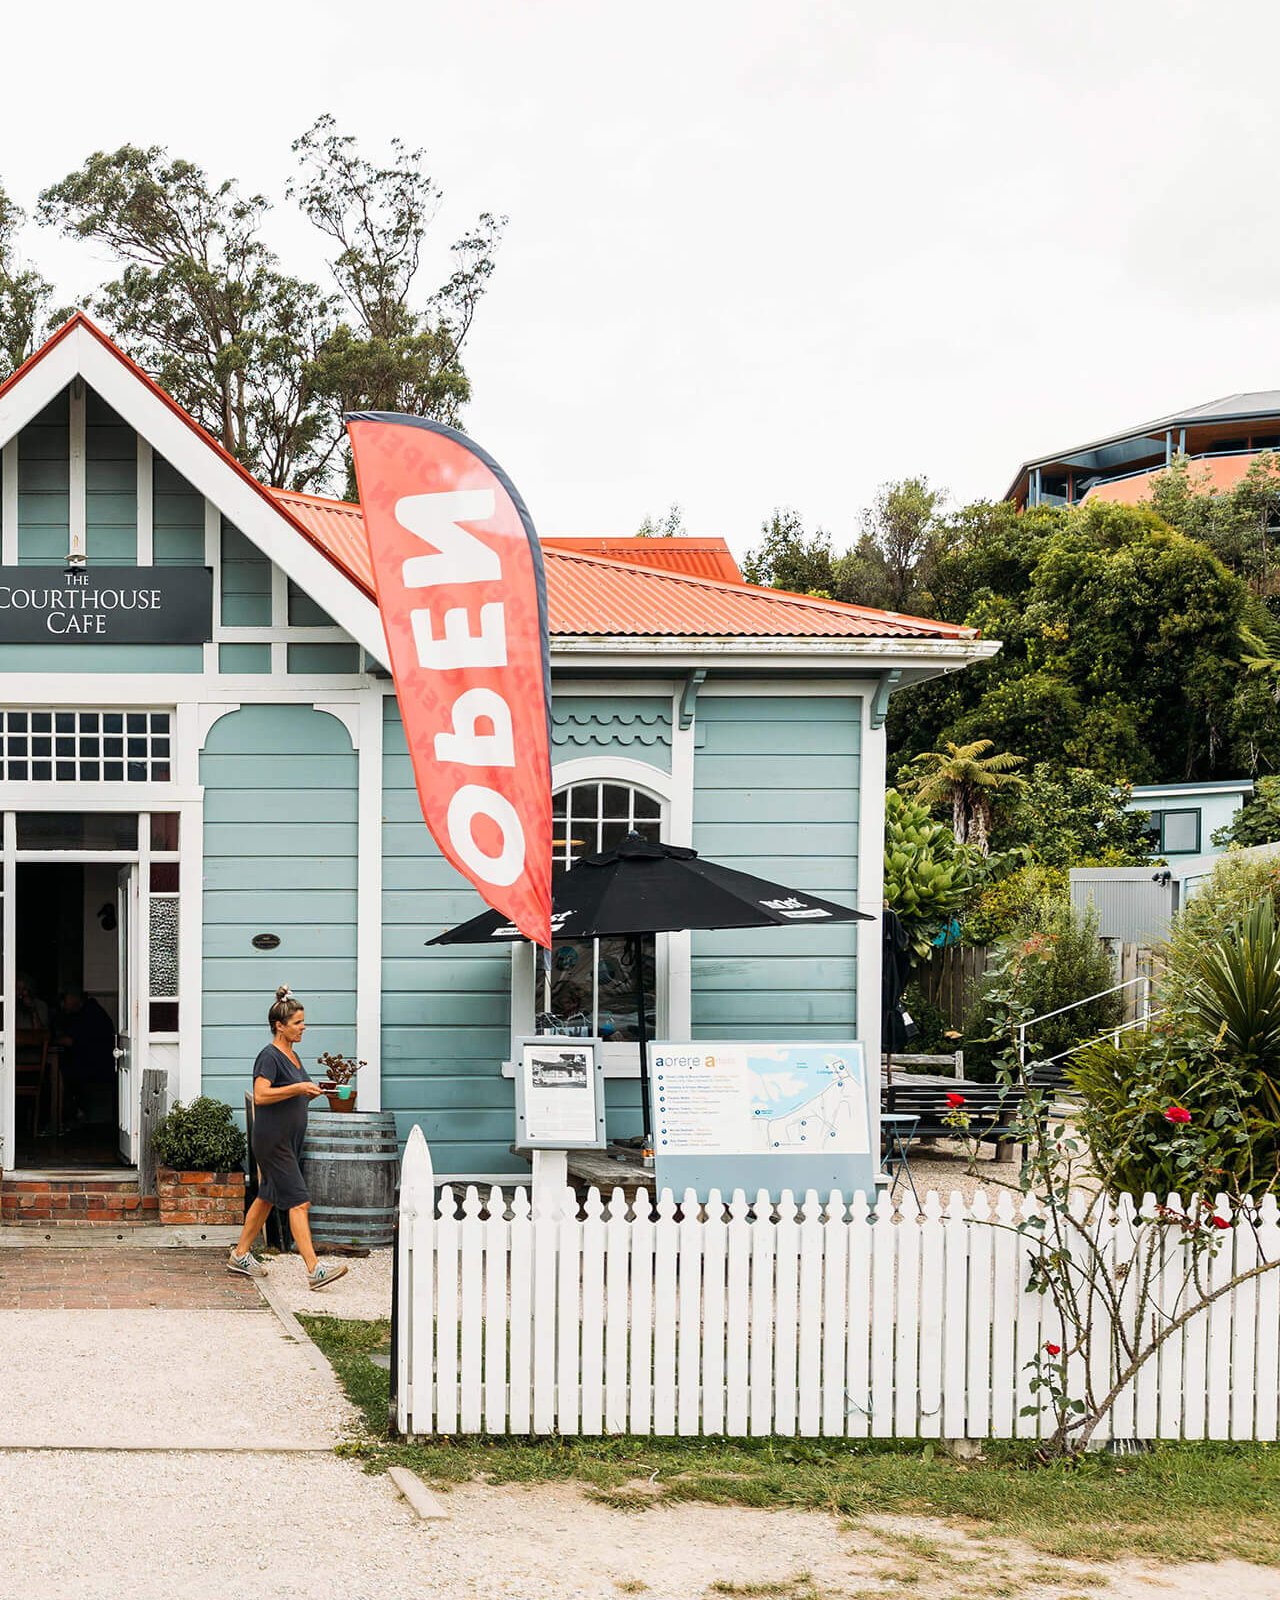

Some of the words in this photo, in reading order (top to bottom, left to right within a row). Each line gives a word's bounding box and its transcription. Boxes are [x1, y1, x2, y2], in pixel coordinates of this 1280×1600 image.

[64, 574, 89, 586] THE
[47, 612, 106, 634] CAFE
[655, 1057, 701, 1067] aorere
